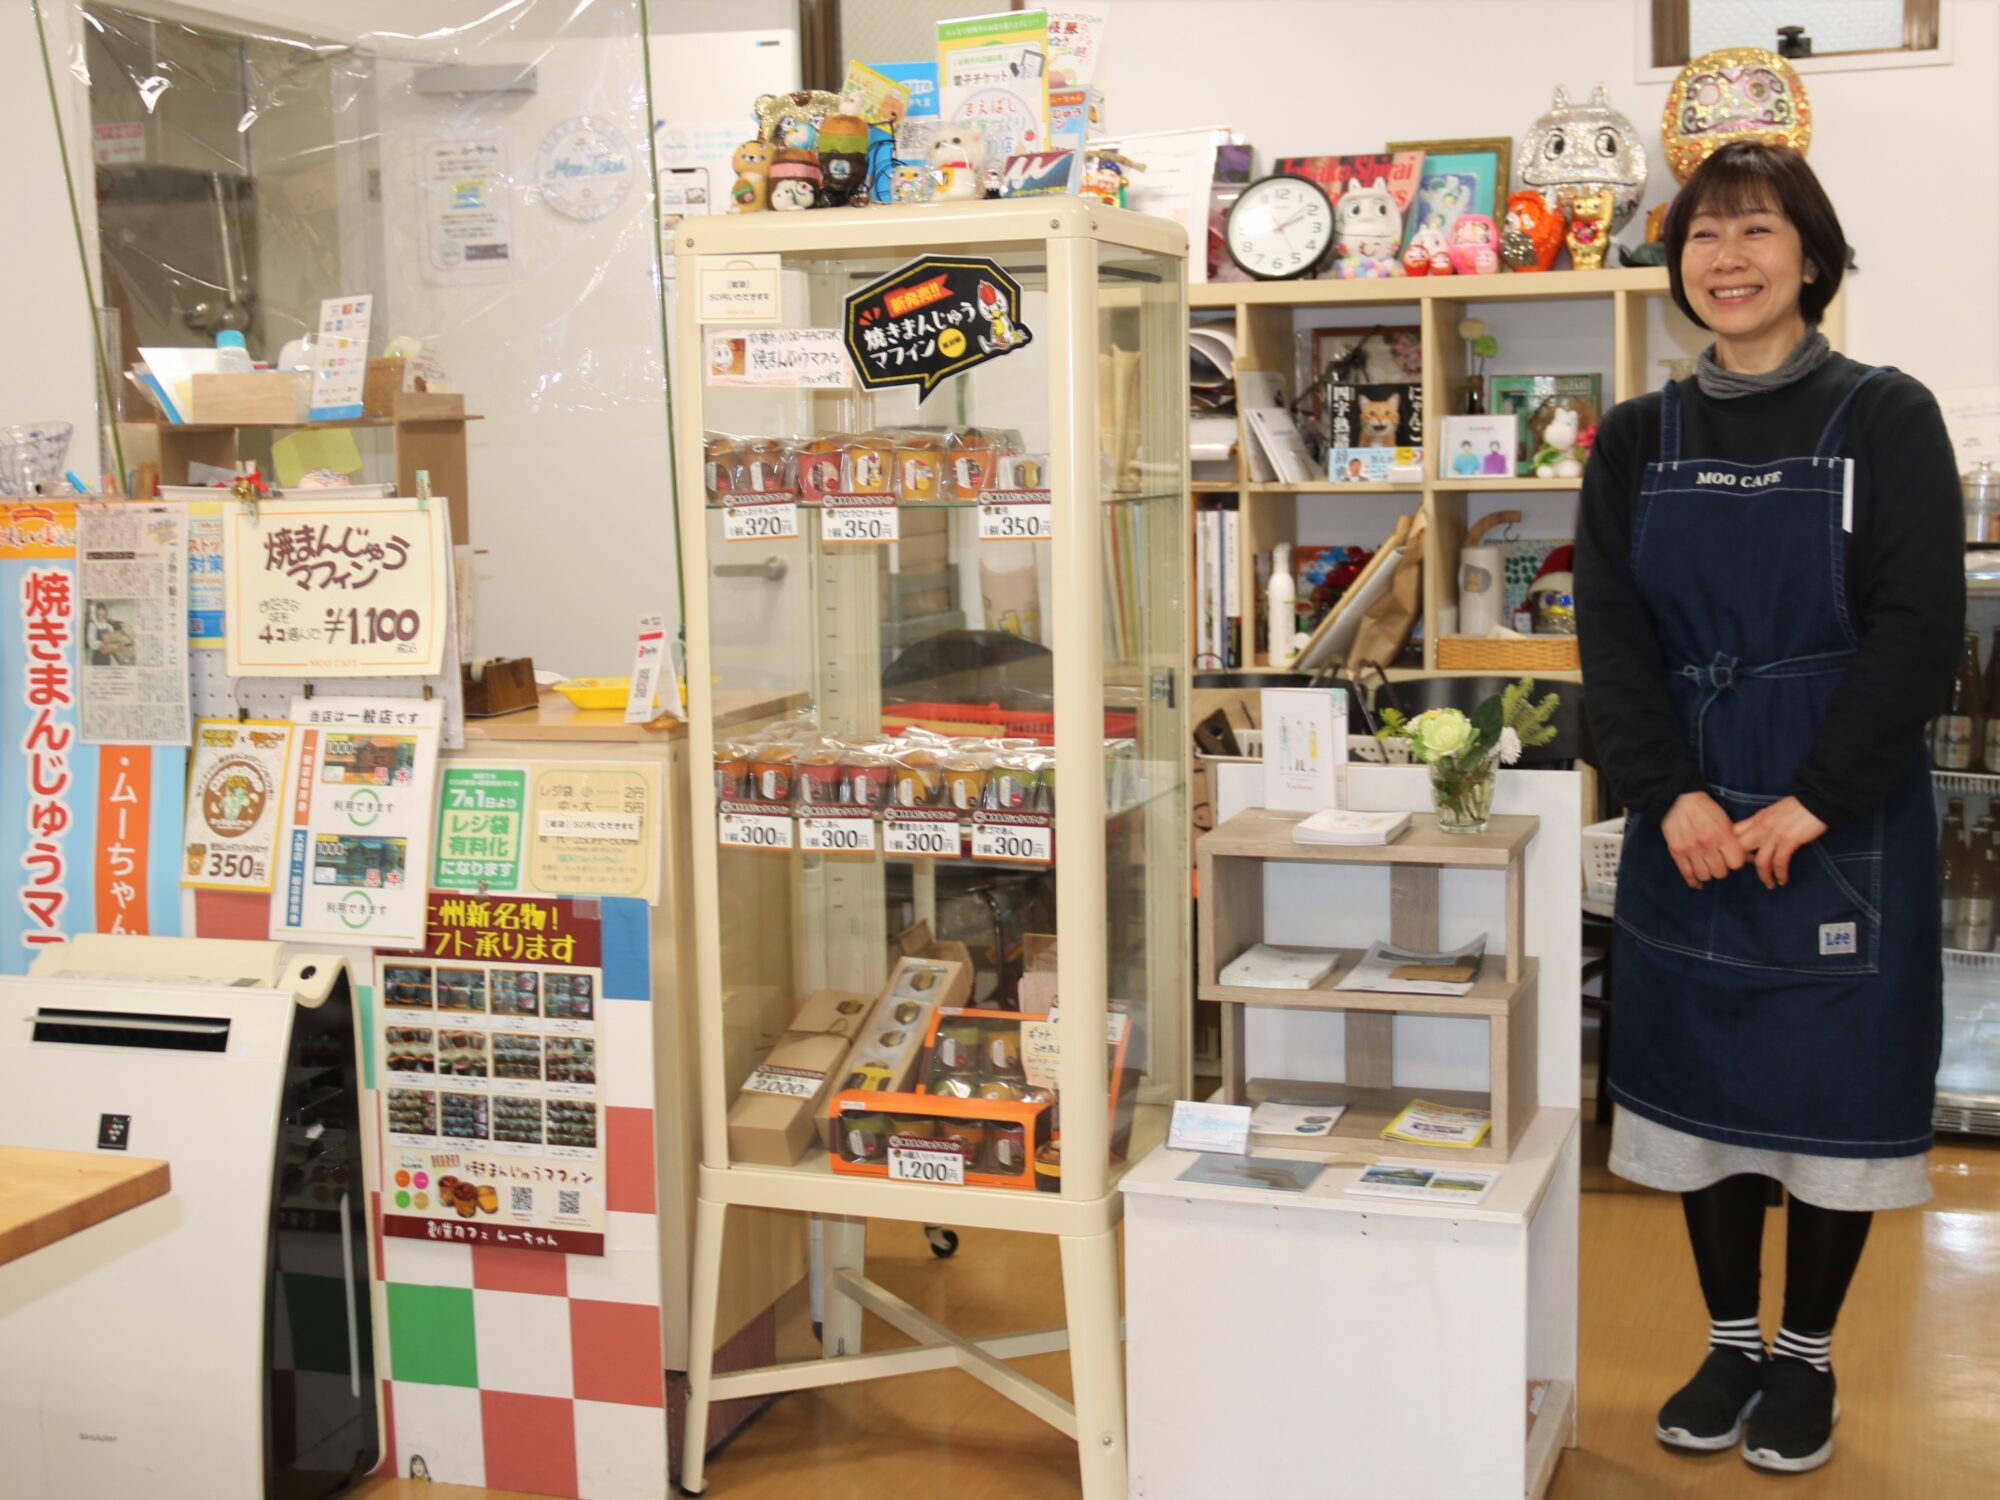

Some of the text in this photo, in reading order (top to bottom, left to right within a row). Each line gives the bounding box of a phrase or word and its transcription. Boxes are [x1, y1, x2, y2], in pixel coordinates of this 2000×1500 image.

[863, 301, 977, 352] 焼きまんじゅう
[869, 338, 936, 370] マフィン
[1696, 470, 1783, 489] MOO CAFE
[264, 524, 411, 572] 焼まんじゅう
[286, 559, 379, 591] マフィン
[309, 709, 421, 725] 当店は一般店です
[24, 572, 71, 943] 焼きまんじゅうマ
[449, 788, 517, 809] 7月1日より
[452, 815, 510, 835] レジ袋
[448, 836, 509, 857] 有料化
[440, 860, 515, 877] になります
[409, 930, 577, 964] フト承ります
[1825, 931, 1850, 946] Lee
